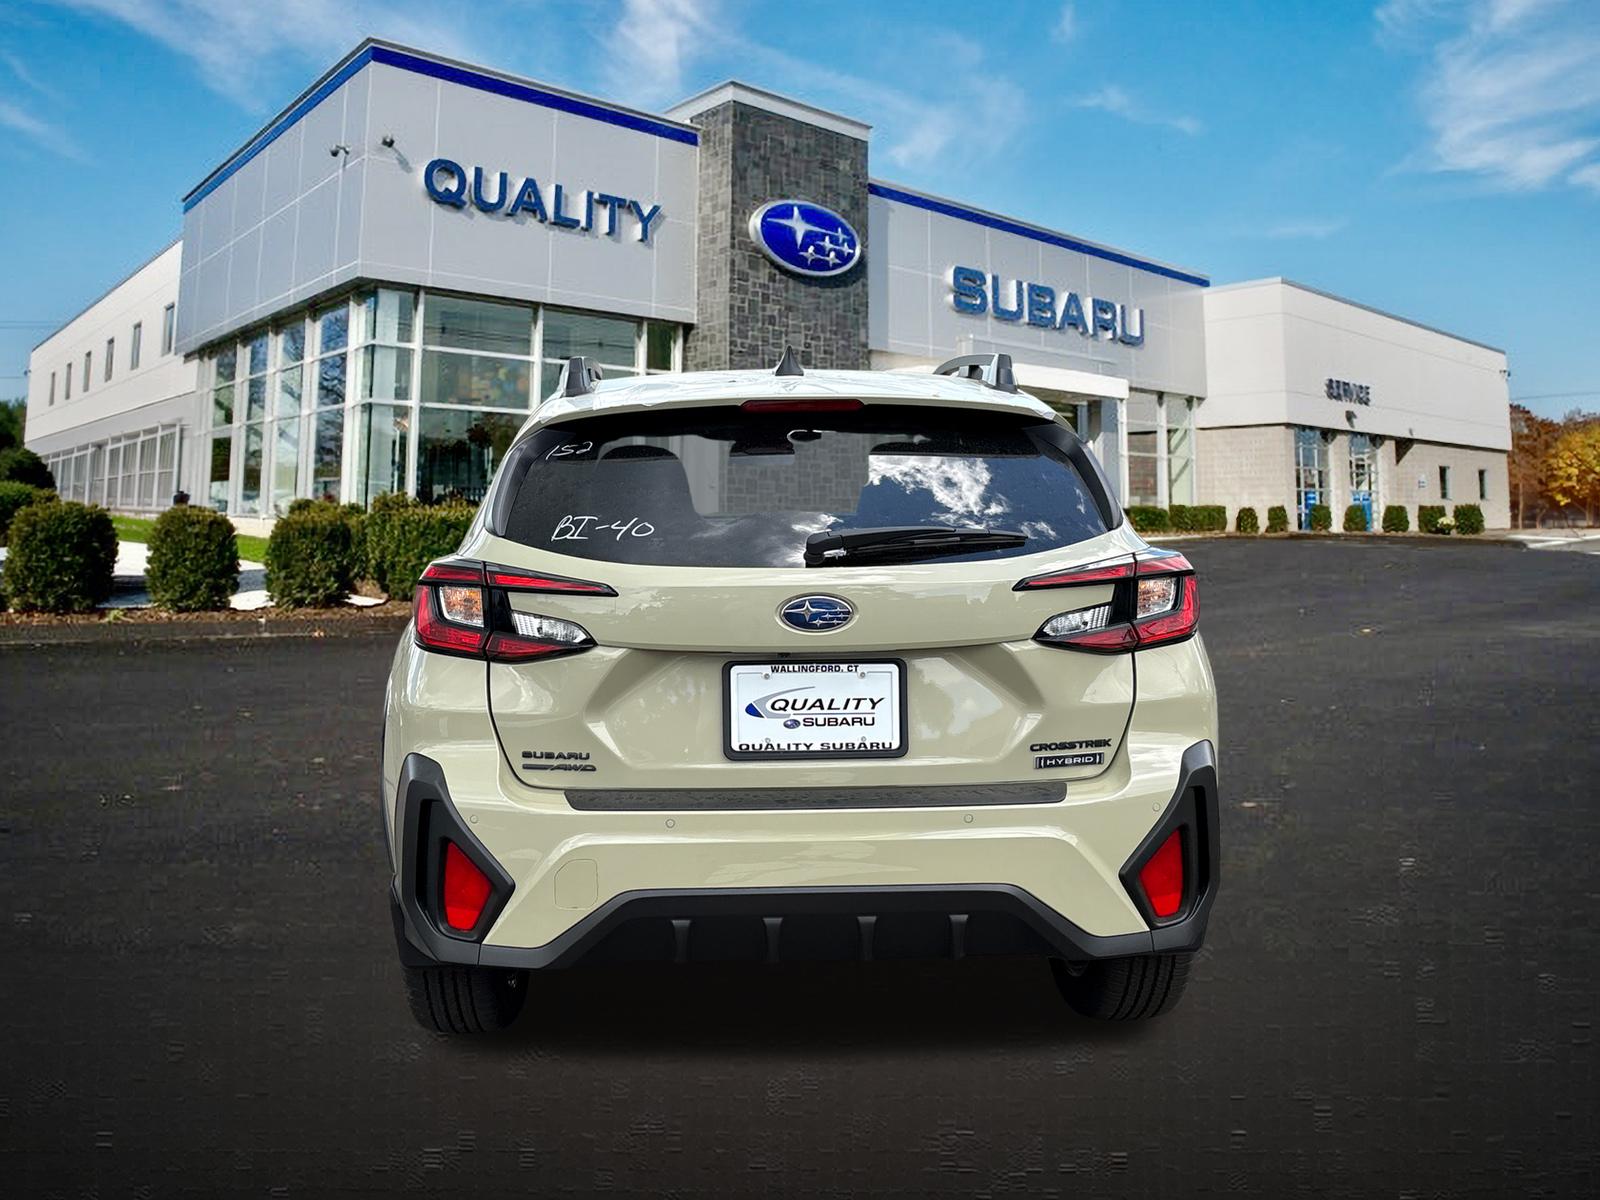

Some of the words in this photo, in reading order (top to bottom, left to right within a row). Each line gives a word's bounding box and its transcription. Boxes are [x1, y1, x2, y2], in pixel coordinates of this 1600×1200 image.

[423, 158, 662, 243] QUALITY
[949, 265, 1145, 347] SUBARU
[846, 664, 859, 673] CT
[770, 697, 885, 712] QUALITY
[802, 717, 875, 727] SUBARU
[738, 742, 812, 751] QUALITY
[820, 741, 892, 750] SUBARU
[1029, 738, 1112, 752] CROSSTREK
[521, 750, 590, 760] SUBARU
[1046, 756, 1094, 766] HYBRID
